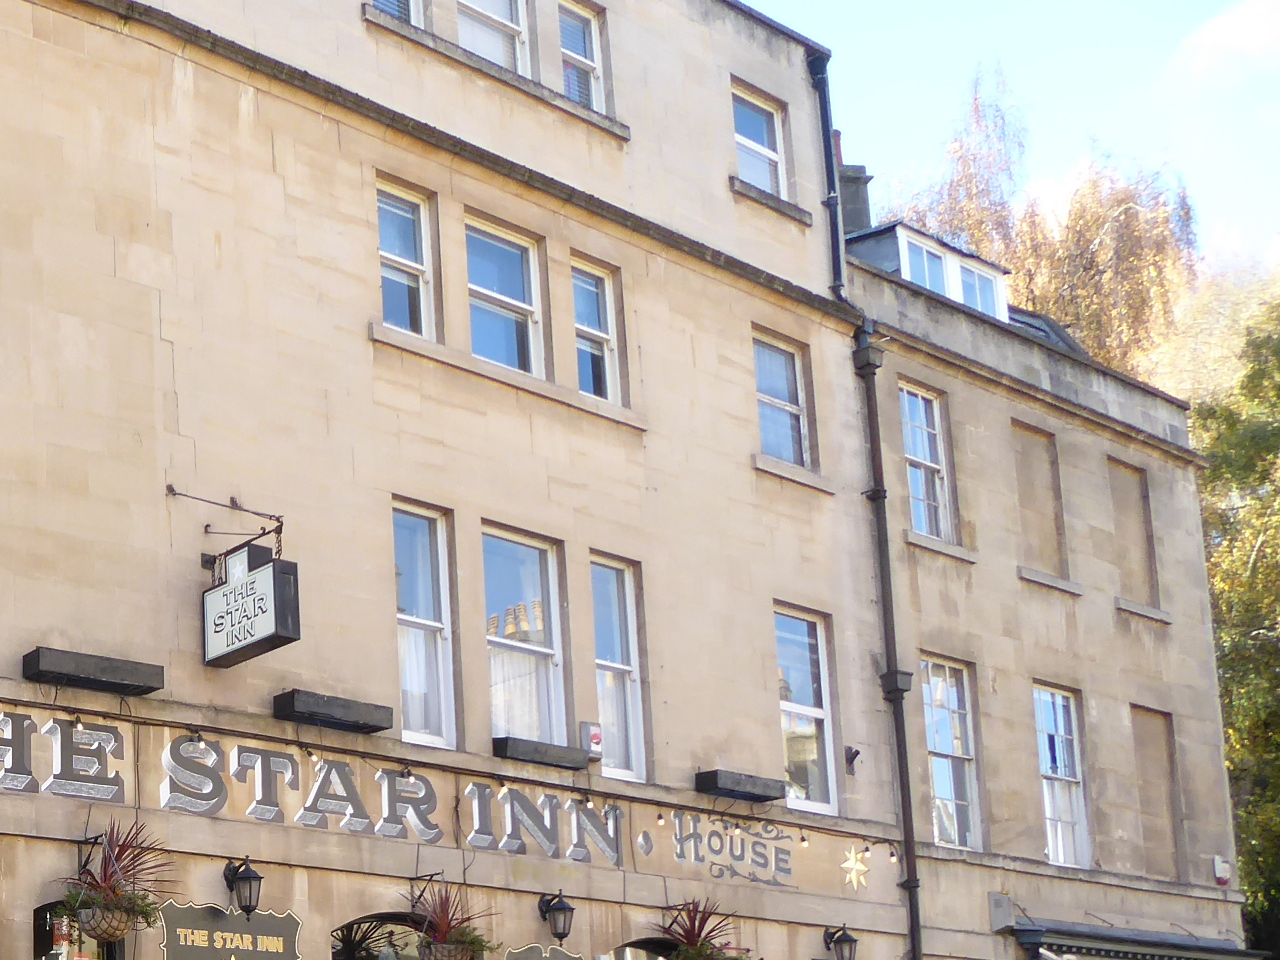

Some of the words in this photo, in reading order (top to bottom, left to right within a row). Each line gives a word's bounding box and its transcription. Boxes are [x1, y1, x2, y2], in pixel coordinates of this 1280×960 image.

[222, 577, 257, 607] THE
[213, 593, 268, 633] STAR
[226, 620, 256, 647] INN
[160, 734, 444, 845] STAR
[464, 781, 624, 867] INN
[177, 927, 209, 947] THE
[213, 931, 253, 950] STAR
[256, 935, 284, 953] INN
